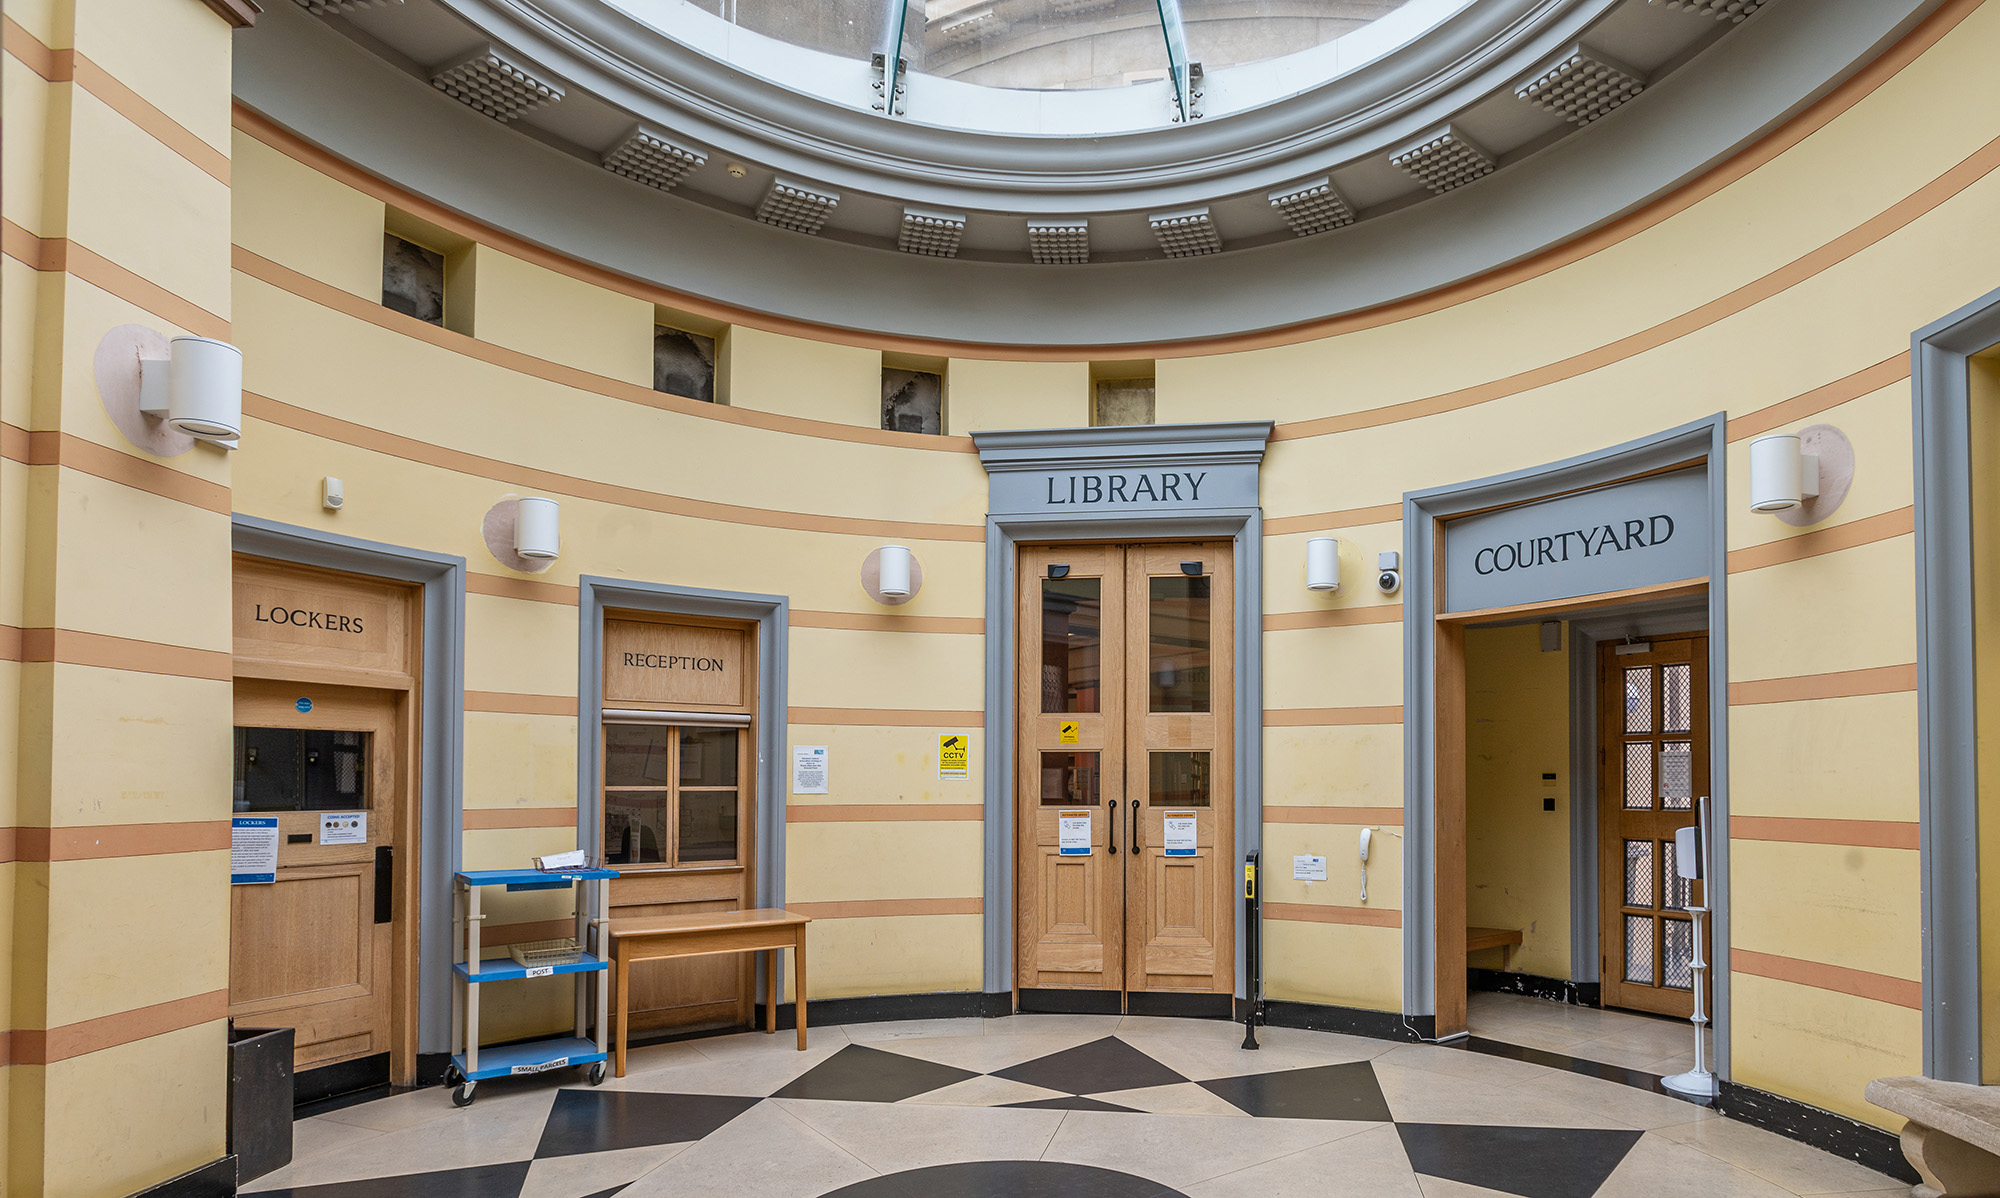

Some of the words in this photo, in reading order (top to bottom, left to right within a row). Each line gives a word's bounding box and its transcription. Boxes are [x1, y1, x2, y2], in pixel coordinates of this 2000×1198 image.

[1046, 472, 1207, 504] LIBRARY
[1474, 514, 1675, 575] COURTYARD
[255, 604, 363, 634] LOCKERS
[623, 652, 723, 672] RECEPTION
[532, 968, 549, 976] POST
[540, 1059, 566, 1071] PARCELS
